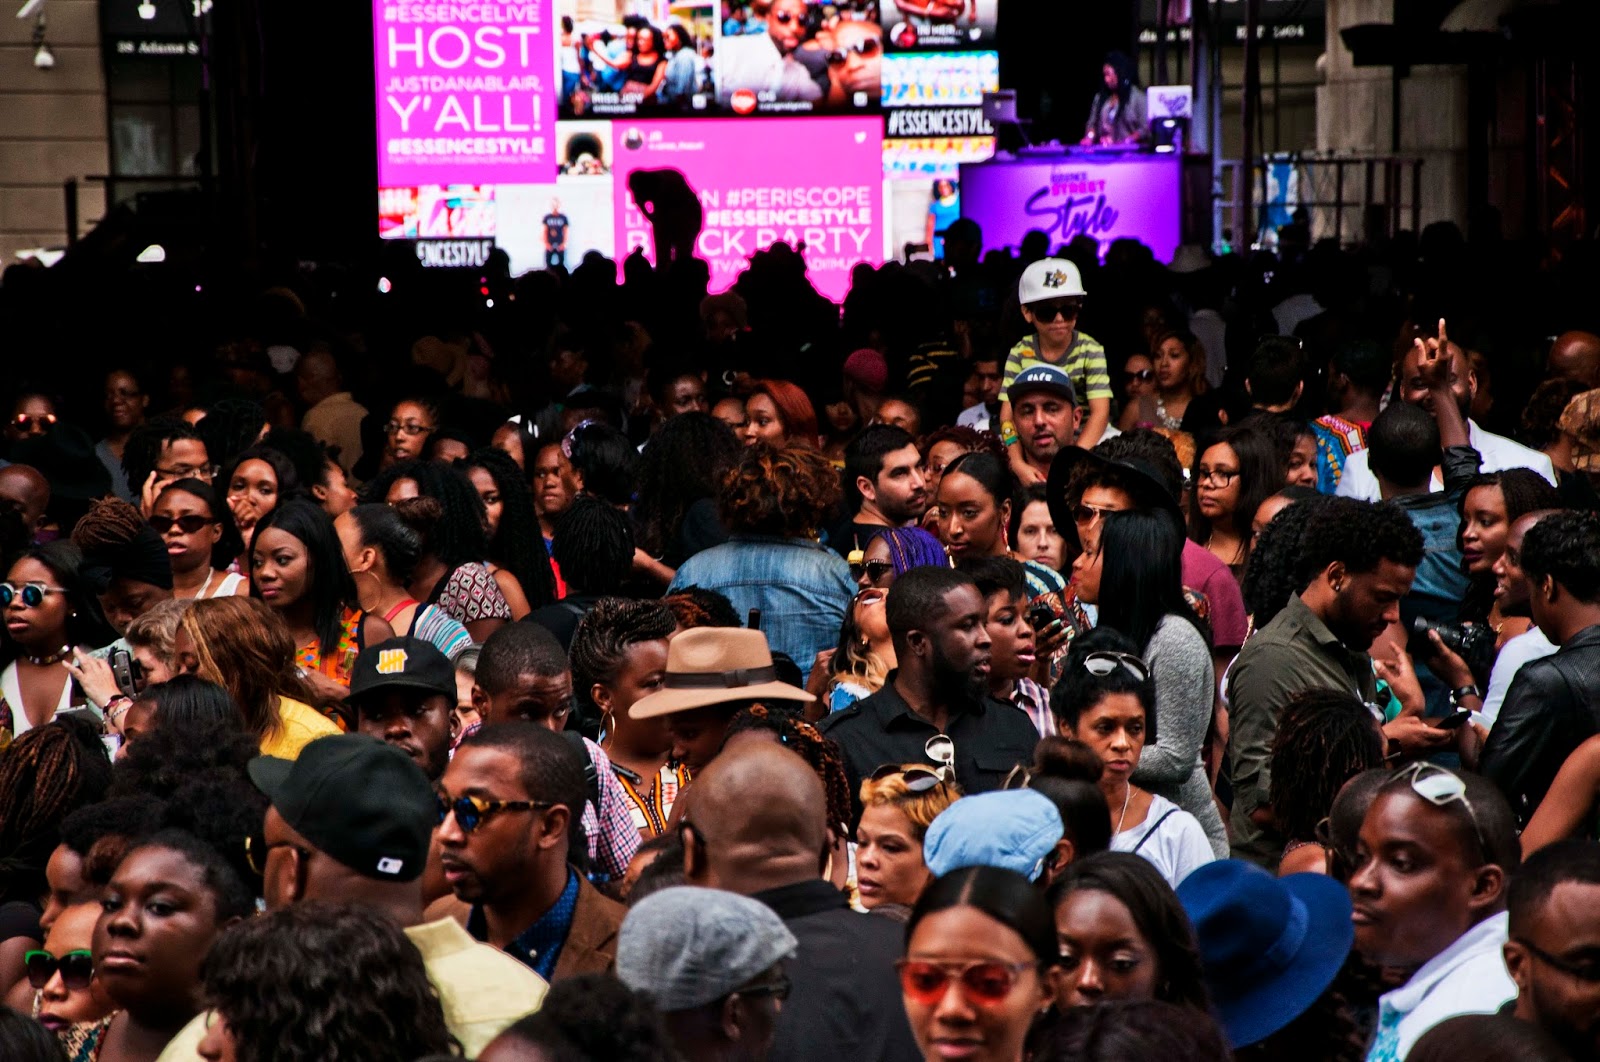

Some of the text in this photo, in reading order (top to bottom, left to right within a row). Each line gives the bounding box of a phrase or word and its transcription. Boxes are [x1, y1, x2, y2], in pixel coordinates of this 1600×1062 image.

[384, 4, 541, 23] #ESSENCELIVE
[387, 25, 541, 69] HOST
[386, 95, 542, 132] Y'ALL!
[387, 137, 545, 155] #ESSENCESTYLE
[727, 186, 871, 208] #PERISCOPE
[706, 207, 872, 227] #ESSENCESTYLE
[1025, 186, 1119, 240] Style
[756, 226, 872, 254] PARTY
